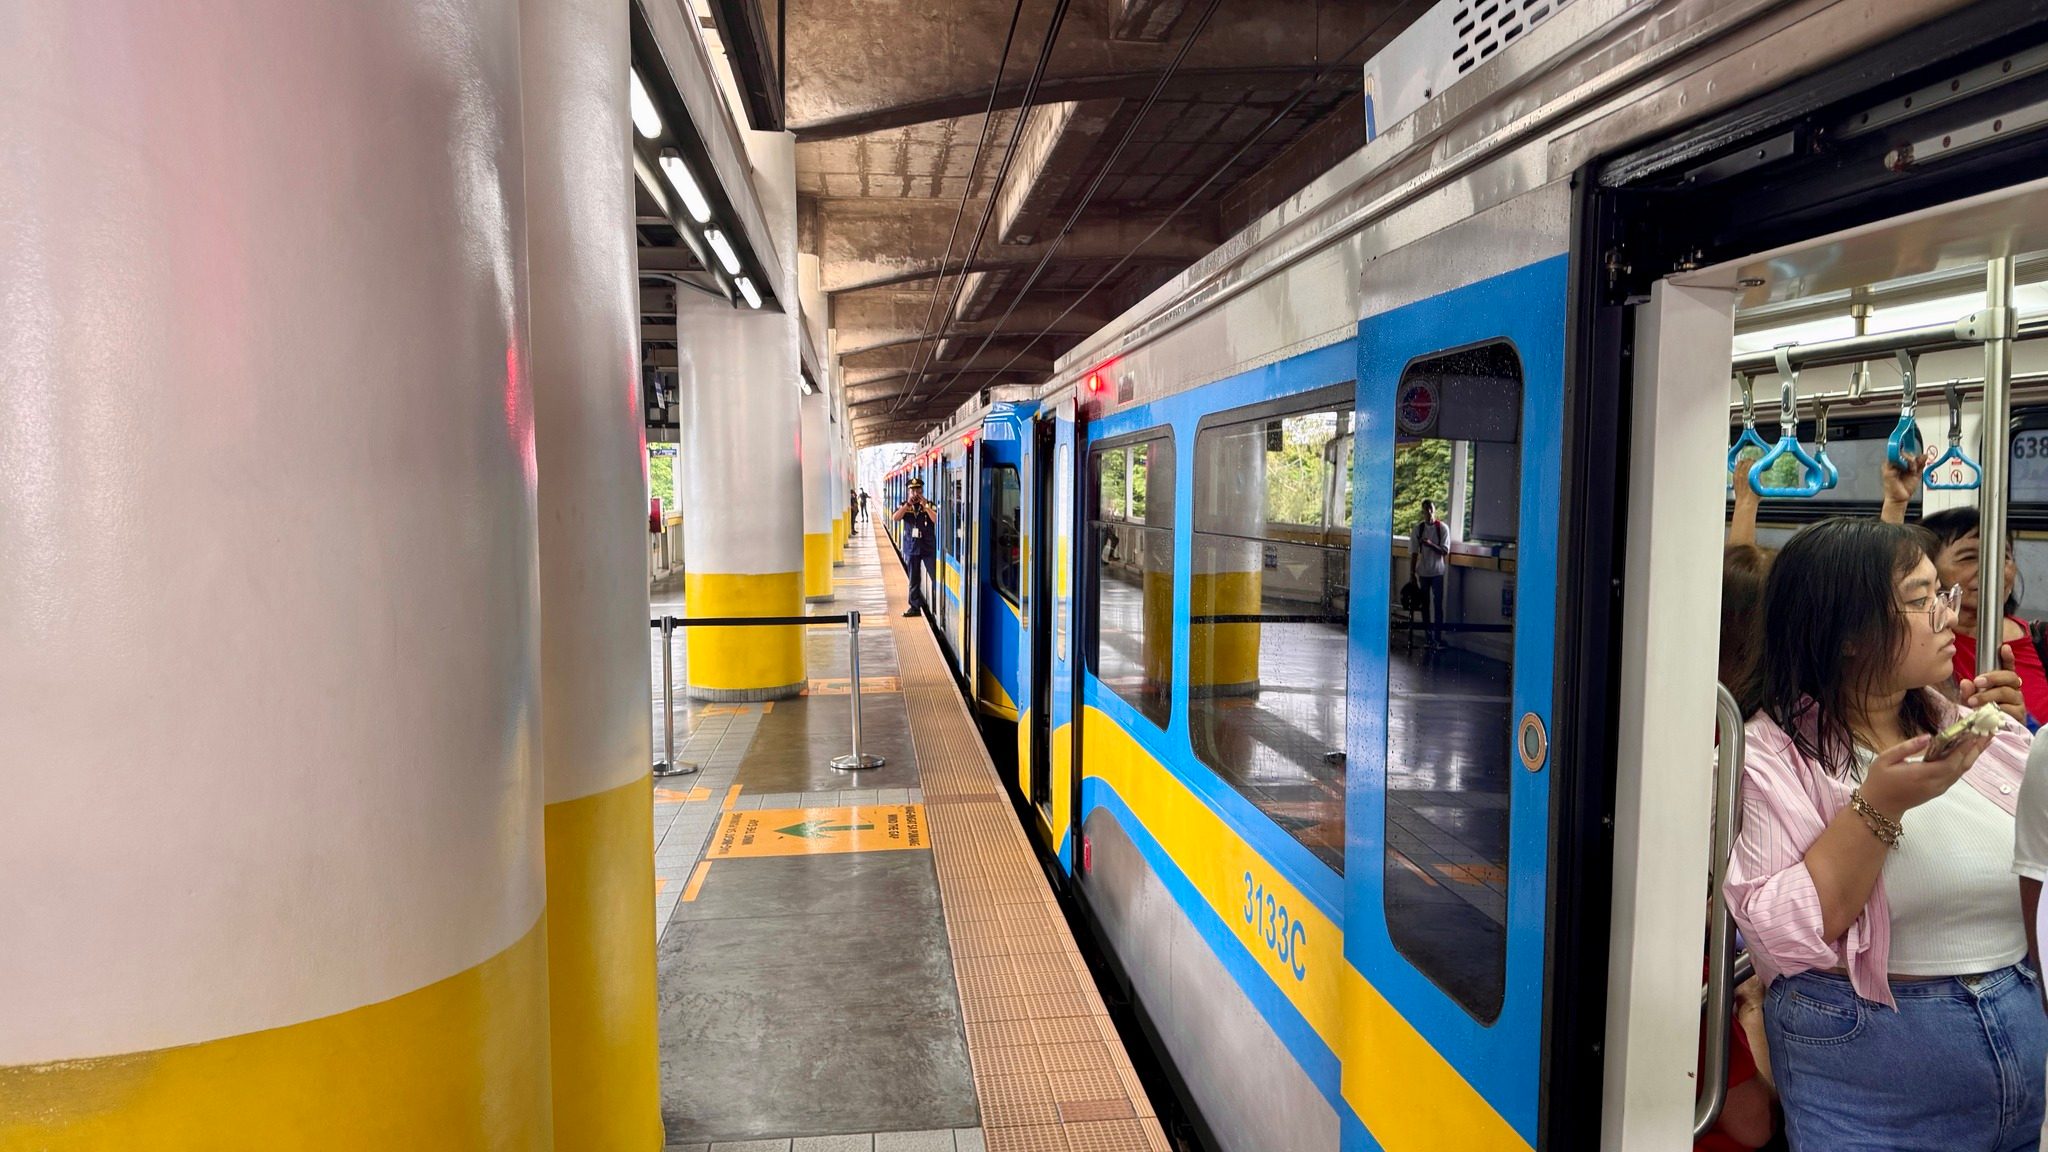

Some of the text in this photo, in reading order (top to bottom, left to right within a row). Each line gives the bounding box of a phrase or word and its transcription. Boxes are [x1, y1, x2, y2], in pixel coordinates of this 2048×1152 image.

[887, 814, 900, 839] MIND THE GAP
[741, 834, 755, 846] MIND
[1243, 871, 1307, 982] 3133C
